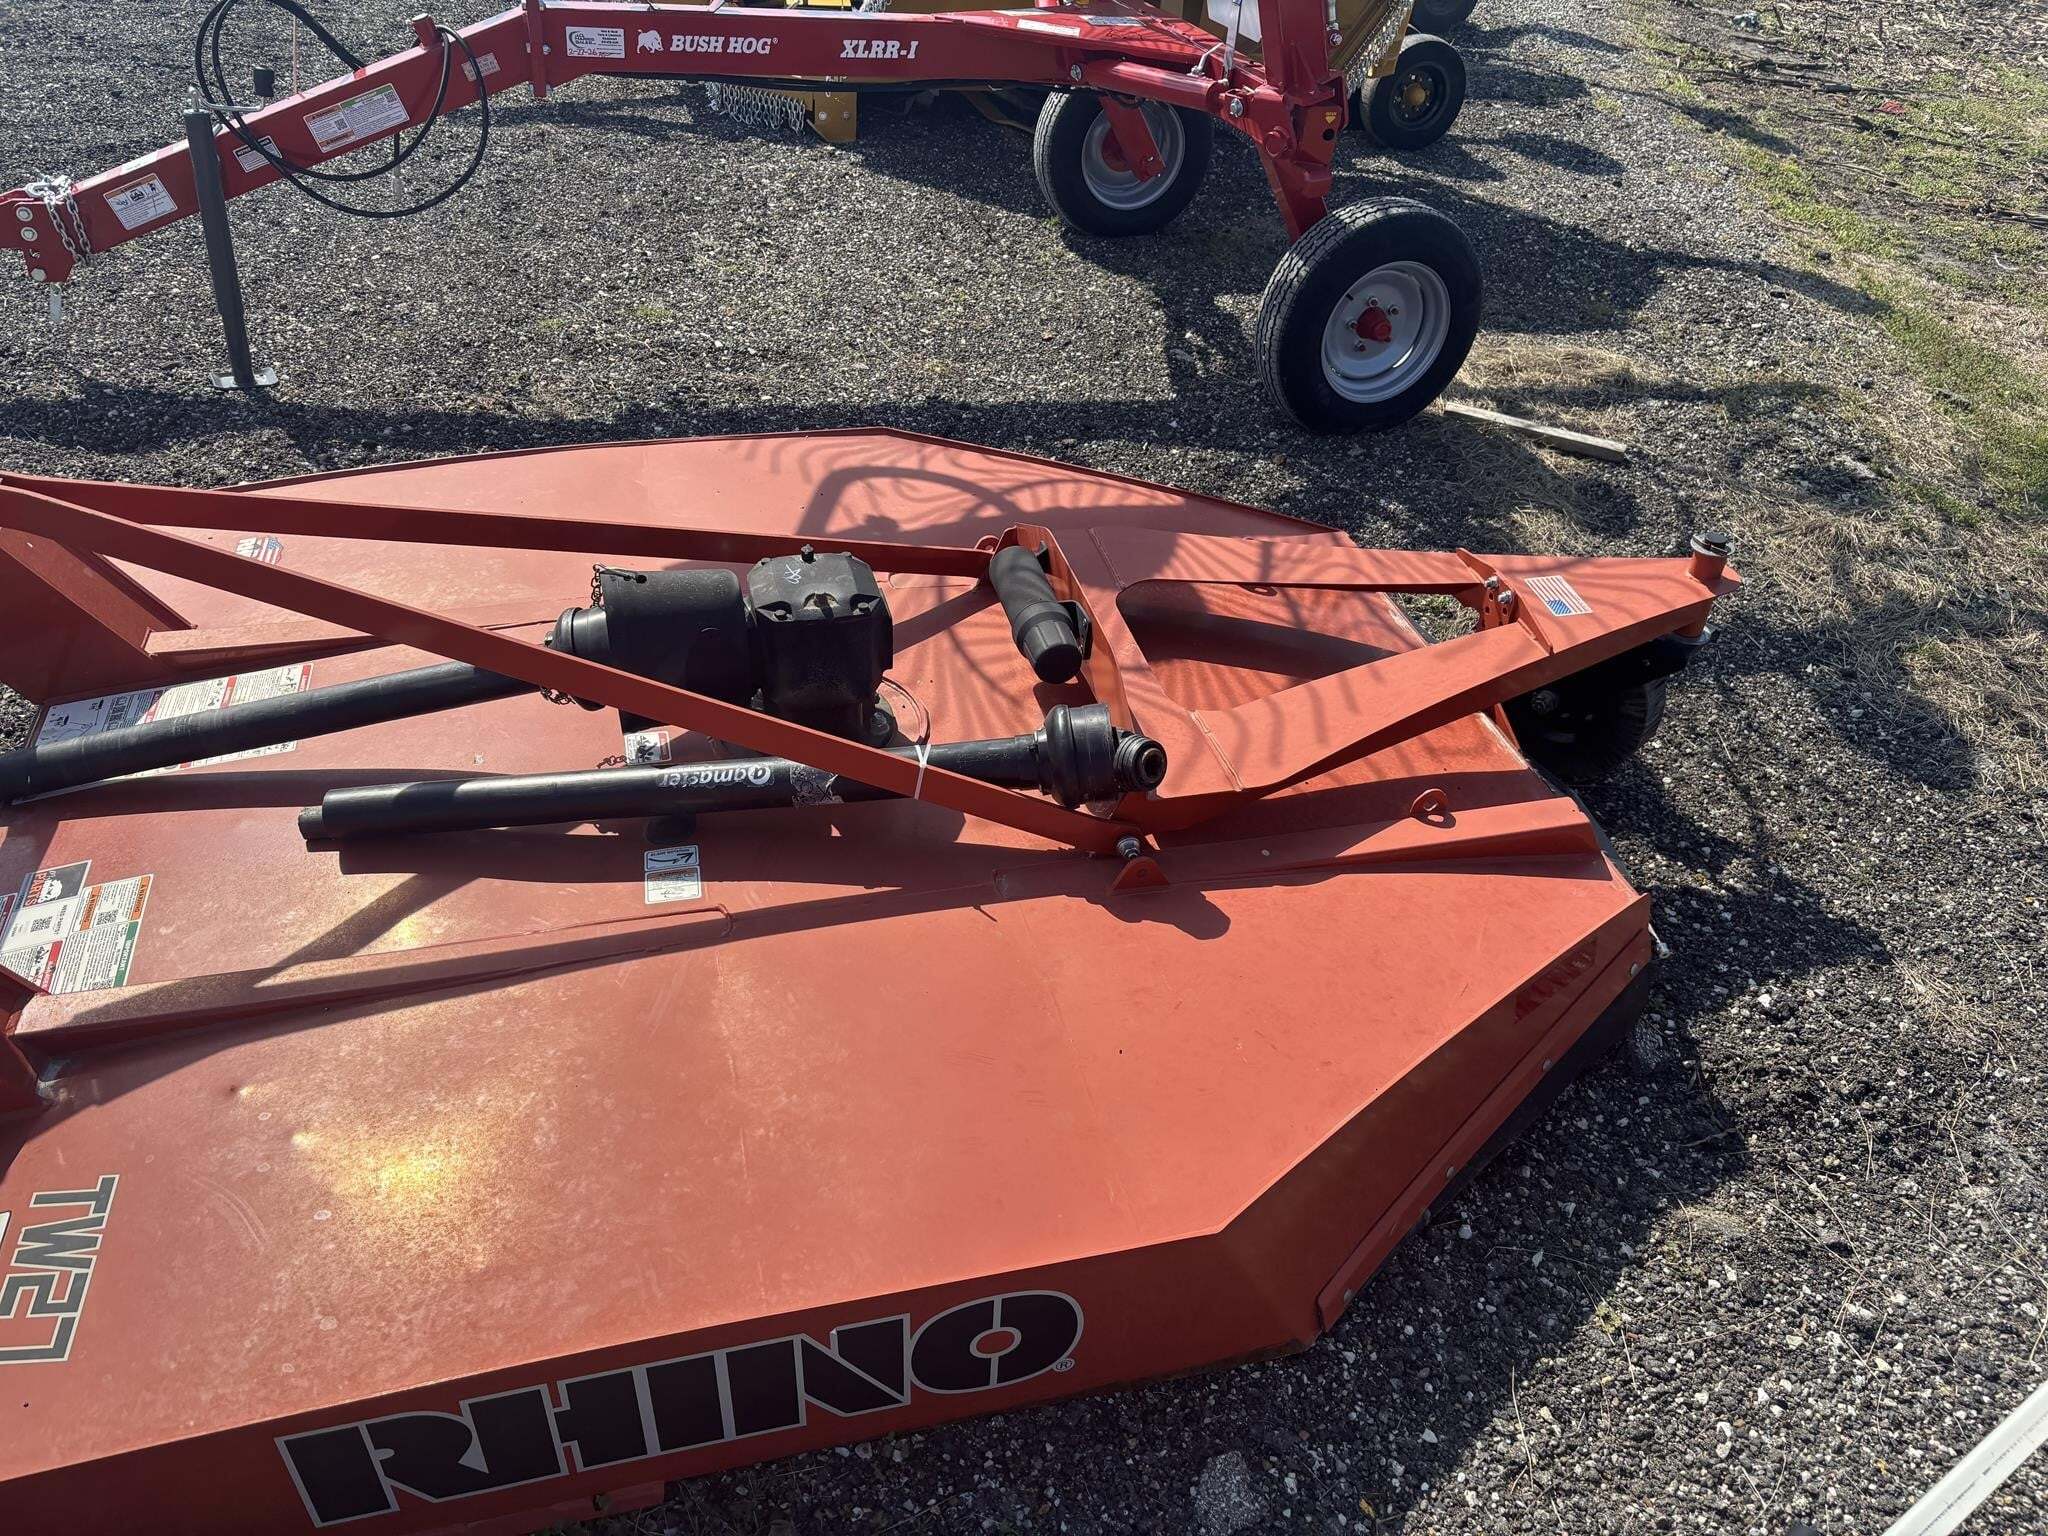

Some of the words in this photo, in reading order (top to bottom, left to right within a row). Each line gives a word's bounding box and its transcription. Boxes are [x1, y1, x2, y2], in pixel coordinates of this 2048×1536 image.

[670, 35, 725, 53] BUSH
[840, 39, 918, 59] XLRR-I
[25, 871, 48, 906] PARTS
